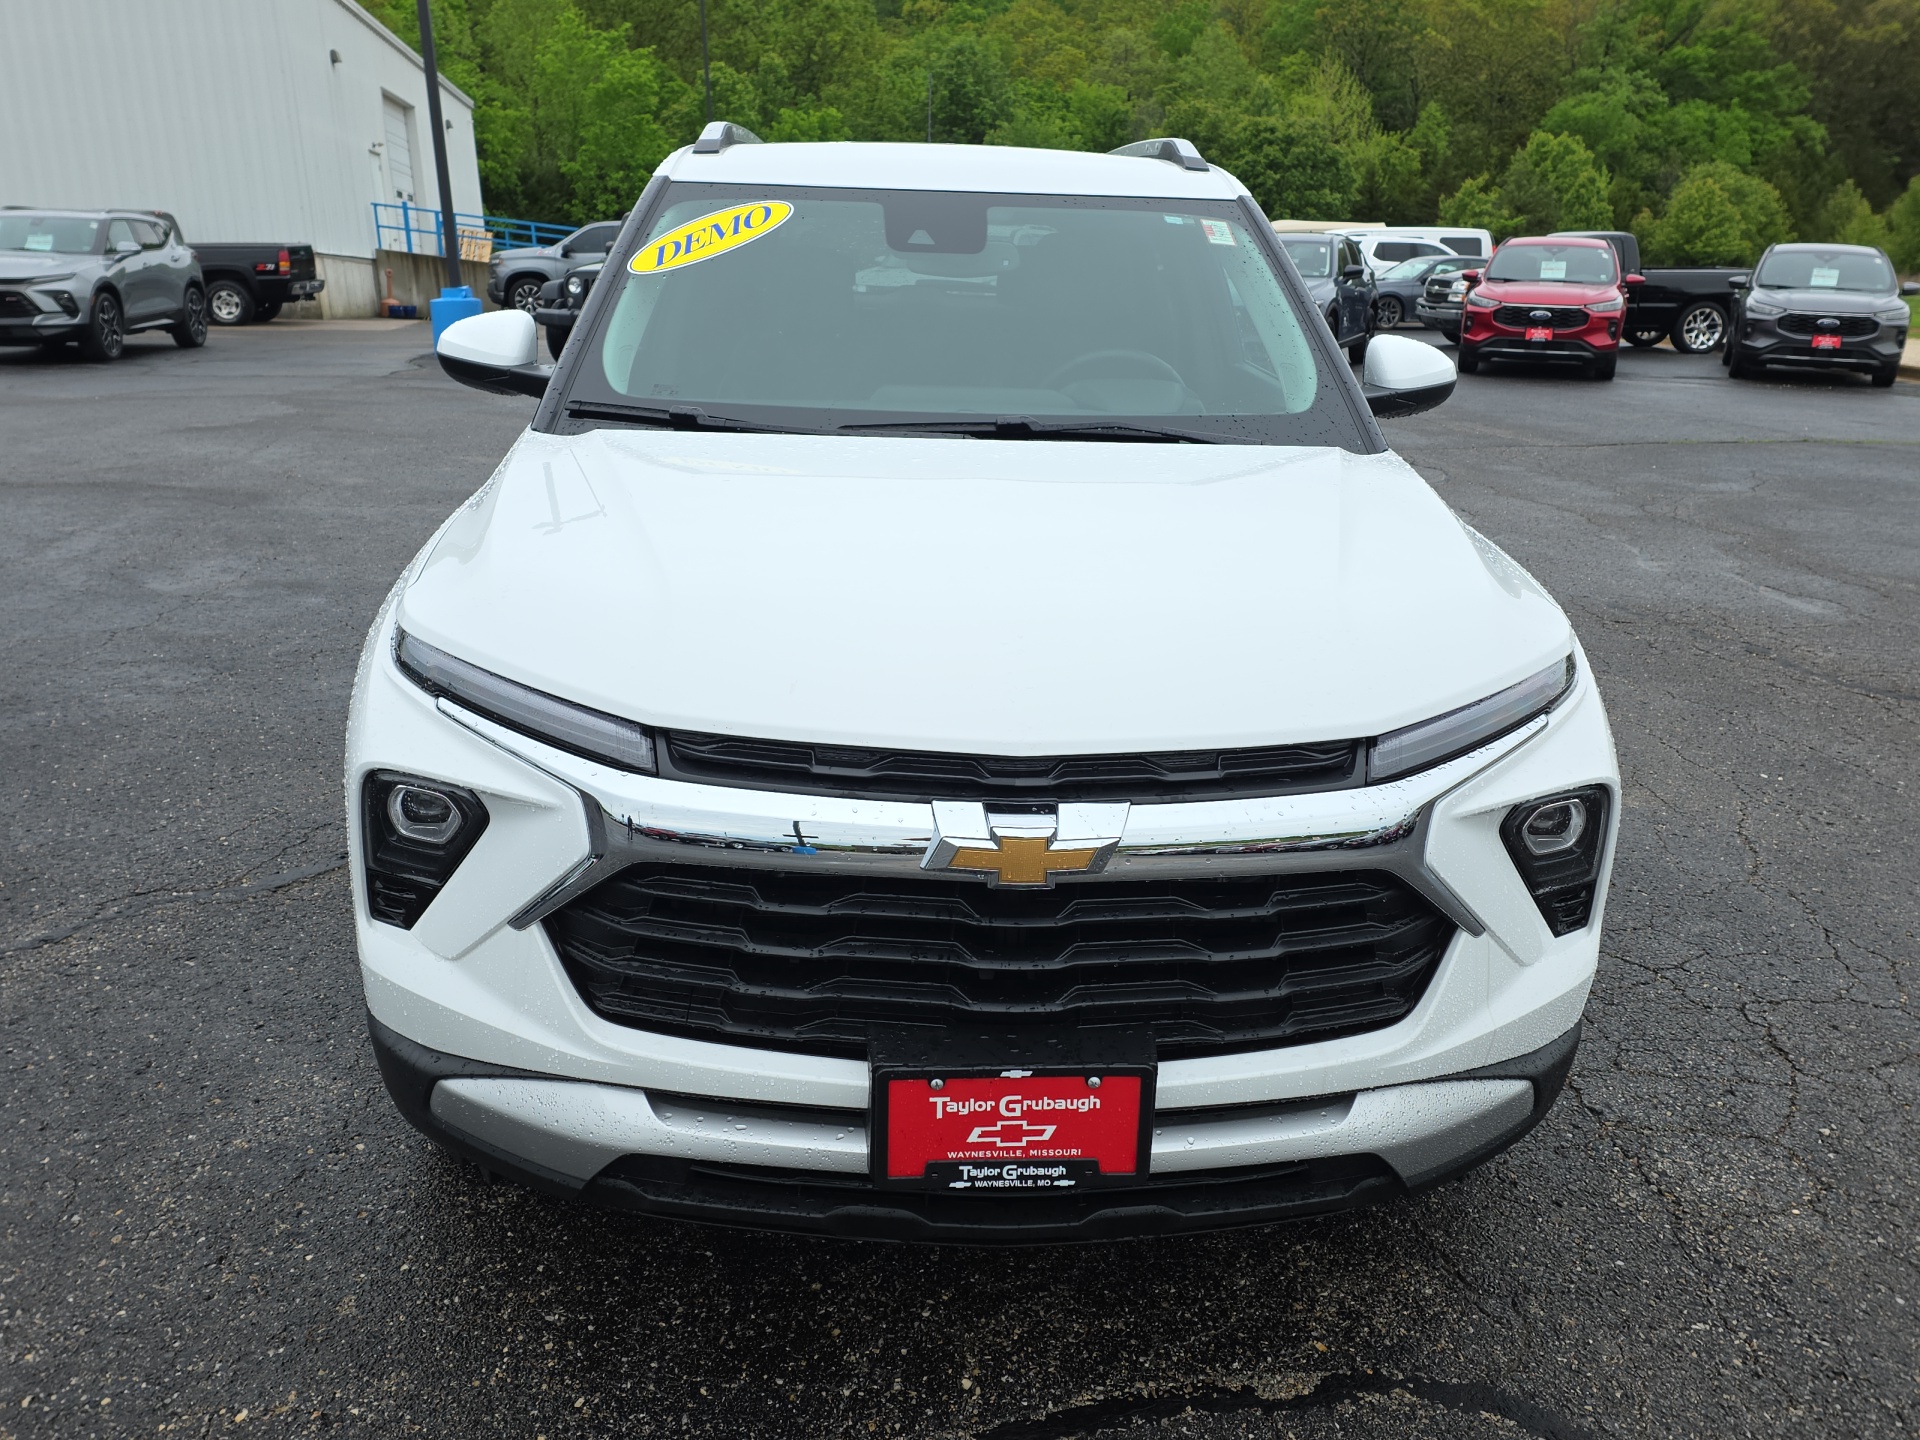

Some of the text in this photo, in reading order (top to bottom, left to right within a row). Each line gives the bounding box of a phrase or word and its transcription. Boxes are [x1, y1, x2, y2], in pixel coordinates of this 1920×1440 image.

[653, 205, 772, 269] DEMO
[929, 1095, 1101, 1119] Taylor Grubaugh
[947, 1148, 1082, 1159] WAYNESVILLE, MISSOURI
[959, 1164, 1067, 1180] Taylor Grubaugh
[974, 1179, 1051, 1188] WAYNESVILLE, MO
